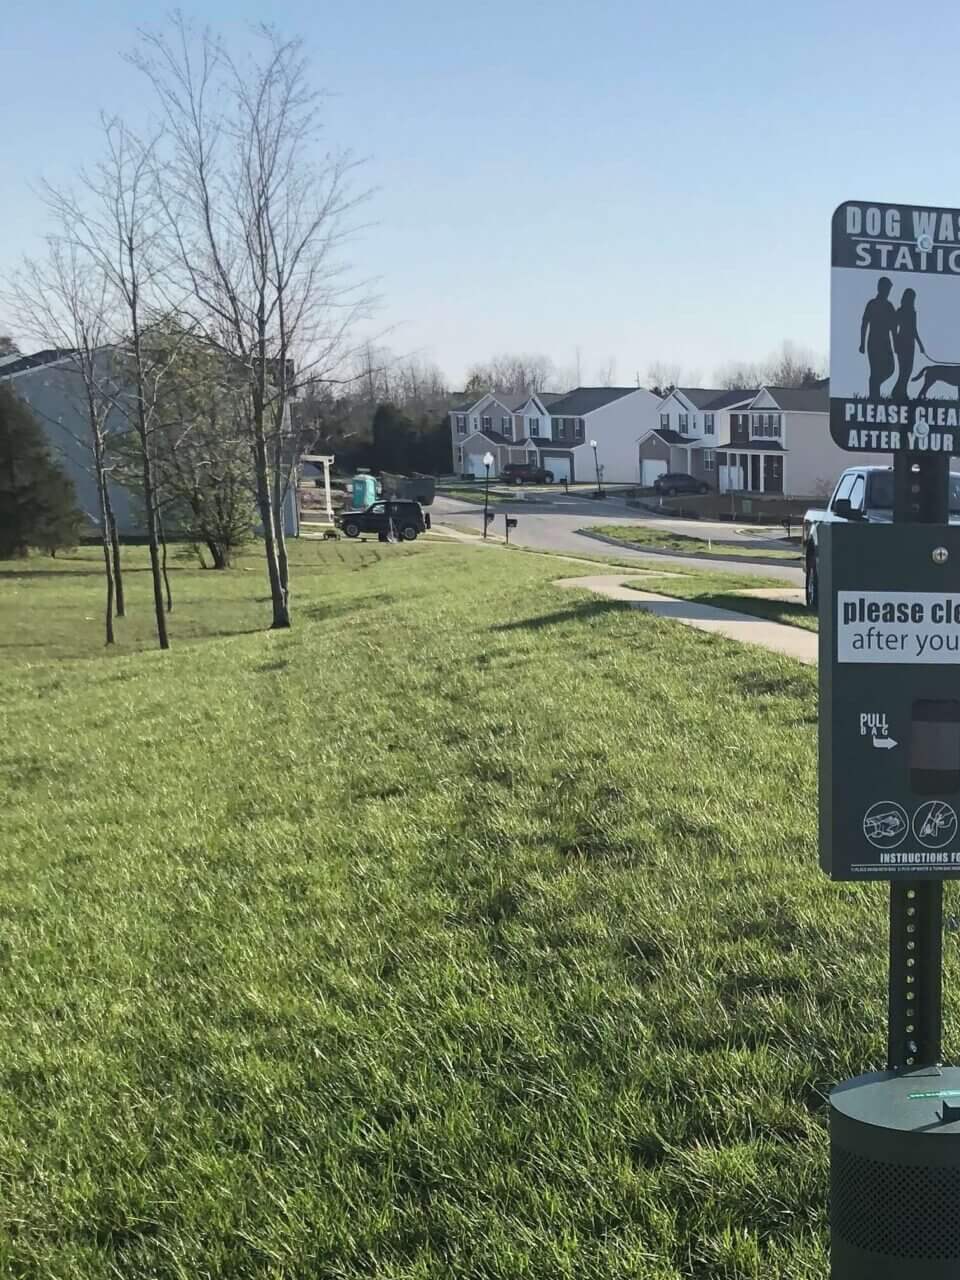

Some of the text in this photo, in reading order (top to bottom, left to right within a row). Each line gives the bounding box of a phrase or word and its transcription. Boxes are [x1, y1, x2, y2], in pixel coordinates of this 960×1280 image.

[846, 207, 901, 238] DOG
[845, 403, 909, 424] PLEASE
[848, 430, 901, 449] AFTER
[908, 431, 954, 451] YOUR
[843, 598, 924, 625] please
[852, 627, 908, 650] after
[859, 713, 888, 728] PULL
[880, 852, 949, 864] INSTRUCTIONS
